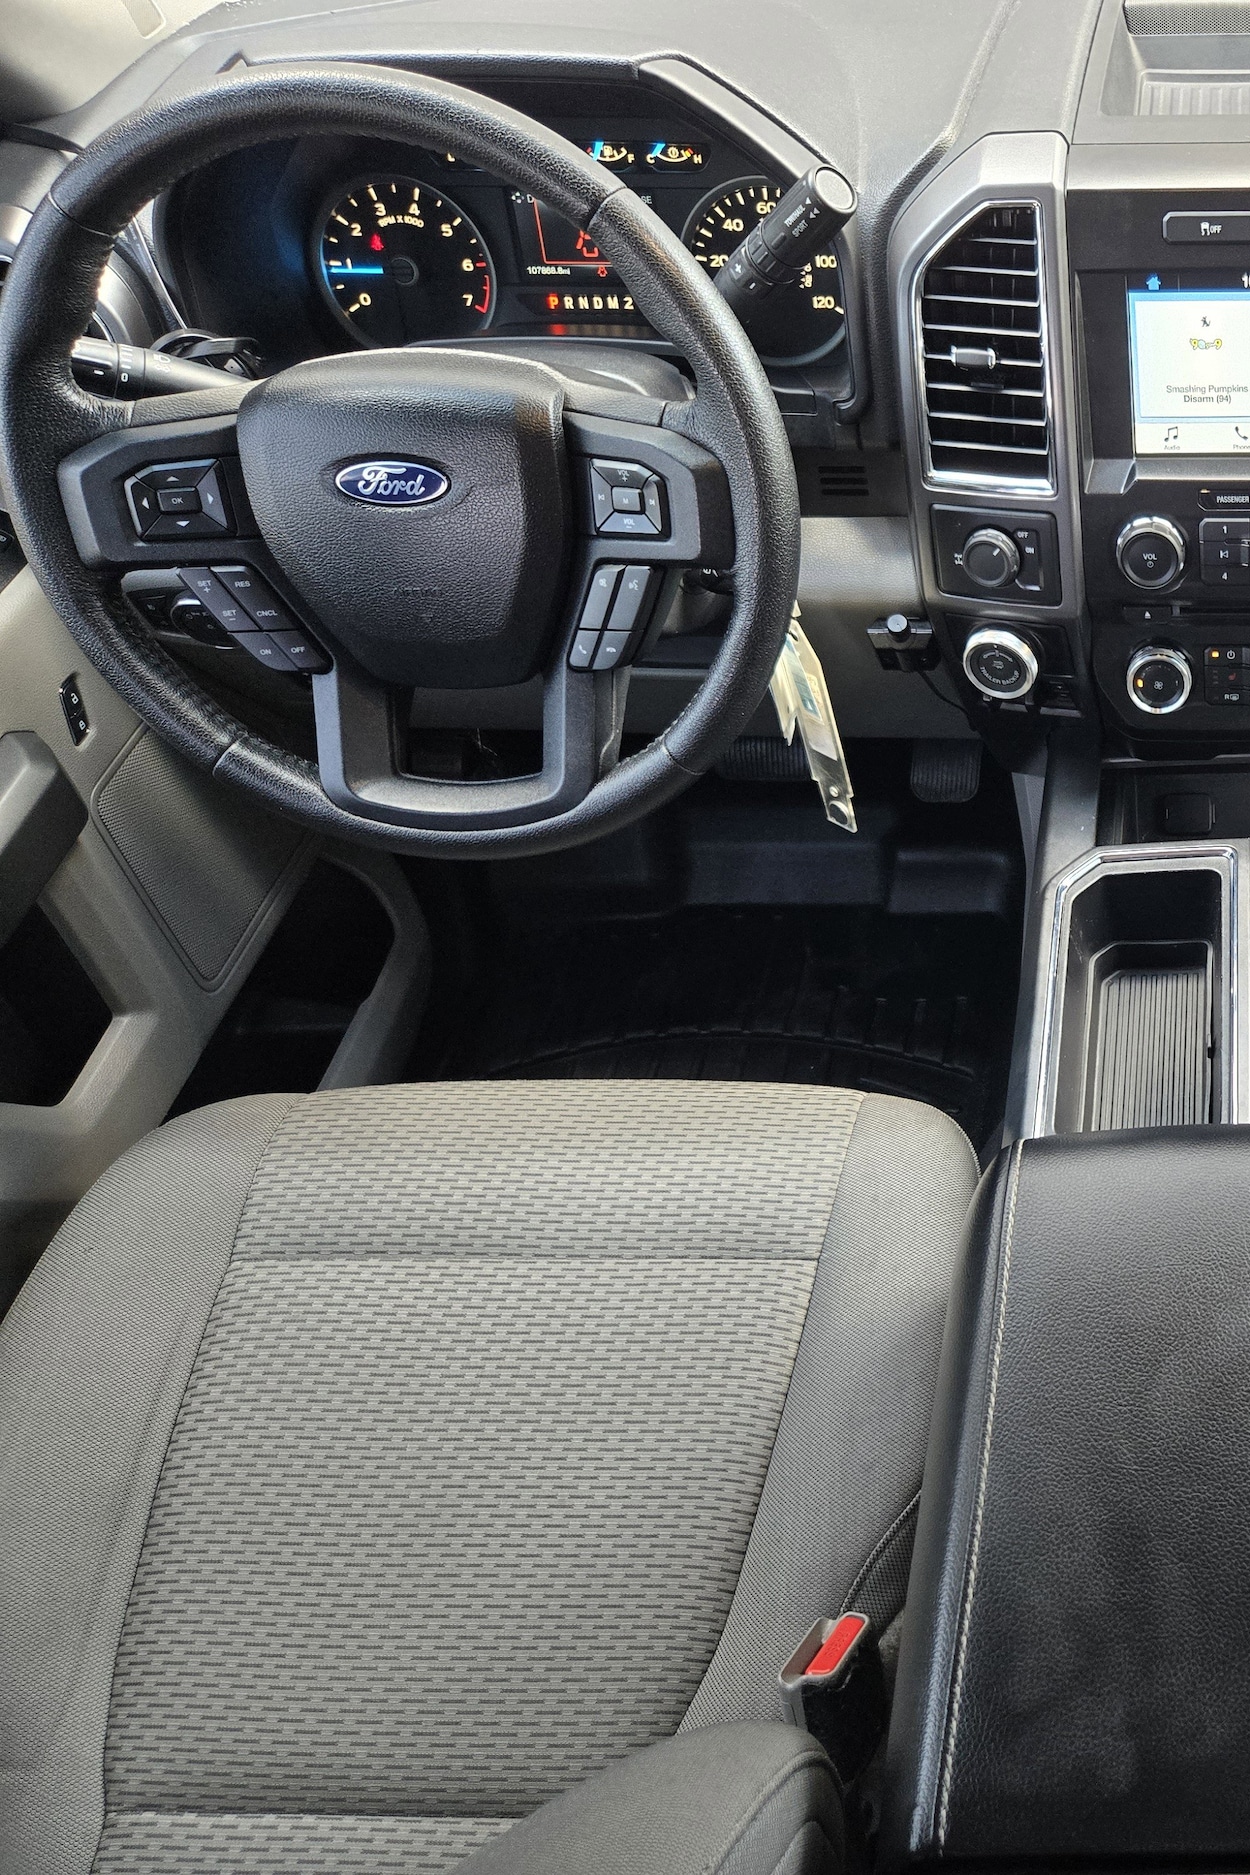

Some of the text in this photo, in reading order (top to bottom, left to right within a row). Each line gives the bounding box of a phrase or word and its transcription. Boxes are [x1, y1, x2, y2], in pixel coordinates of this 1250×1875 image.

[627, 154, 635, 163] F
[646, 154, 655, 163] C
[693, 154, 702, 164] H
[374, 202, 386, 216] 3
[409, 203, 420, 216] 4
[378, 215, 396, 228] RPM
[404, 215, 424, 228] 1000
[723, 218, 744, 232] 40
[792, 219, 809, 237] SPORT
[350, 223, 362, 237] 2
[441, 224, 453, 237] 5
[1210, 225, 1222, 234] OFF
[462, 258, 474, 272] 6
[710, 255, 729, 268] 20
[815, 254, 837, 268] 100
[359, 293, 371, 306] 0
[462, 294, 473, 306] 7
[549, 296, 634, 309] P R N D M 2
[812, 296, 835, 309] 120
[1166, 385, 1248, 394] Smashing Pumpkins
[1183, 394, 1232, 404] Disarm (94)
[357, 466, 425, 495] Ford
[1216, 495, 1249, 503] PASSENGER
[1222, 572, 1228, 580] 4
[980, 666, 1001, 684] TRAILER
